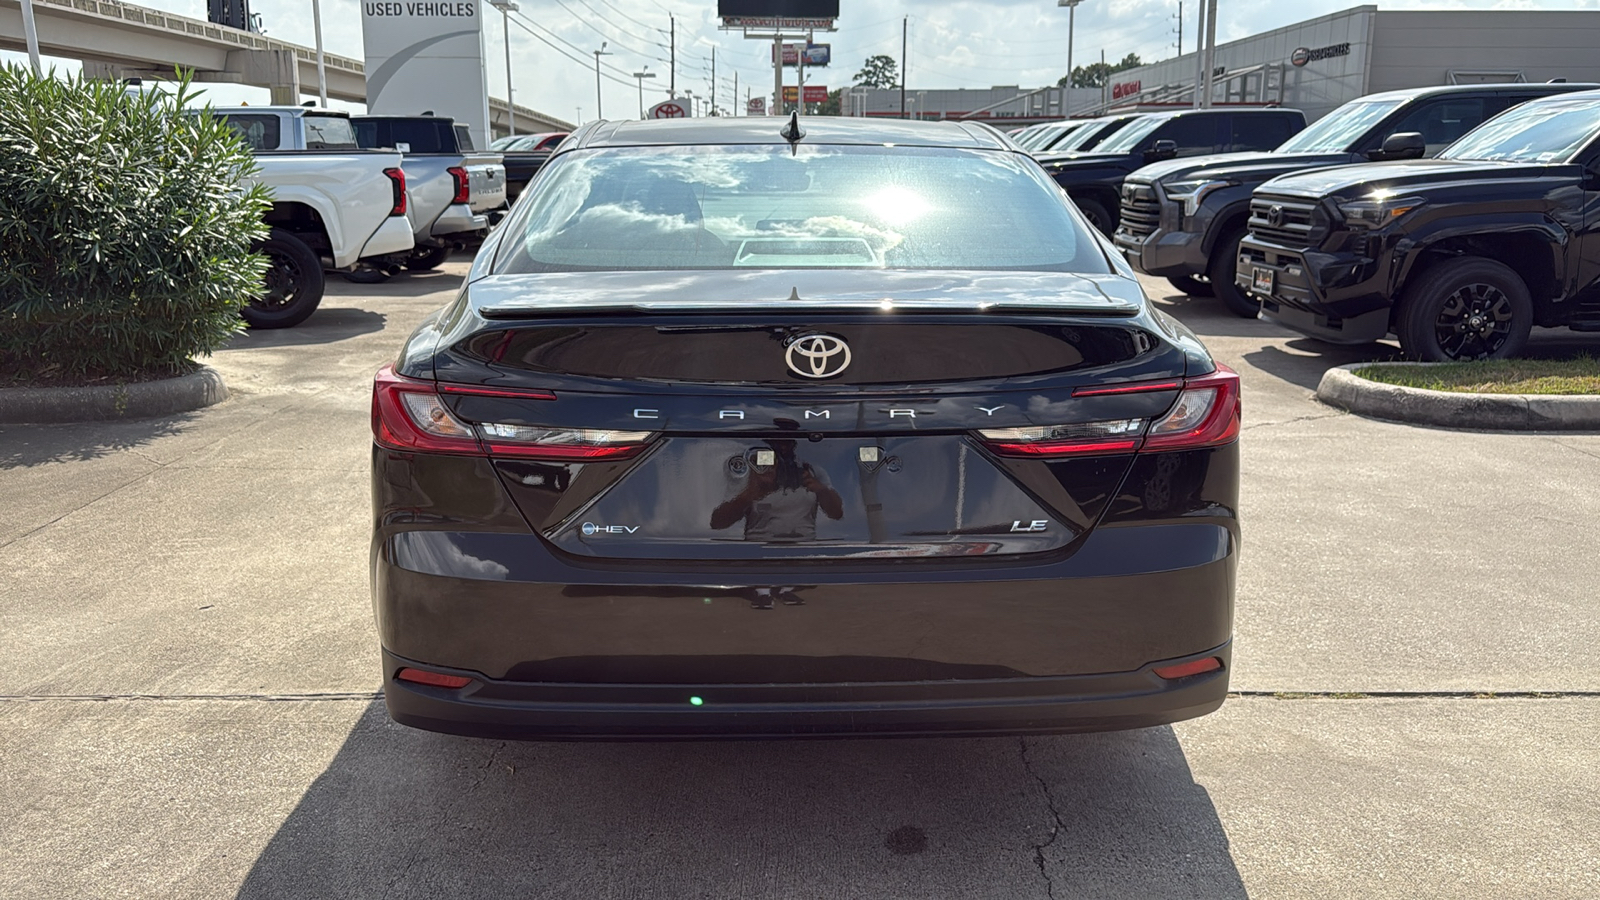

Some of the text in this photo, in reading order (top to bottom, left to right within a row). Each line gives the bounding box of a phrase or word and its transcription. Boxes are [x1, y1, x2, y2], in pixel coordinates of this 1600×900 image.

[366, 2, 474, 16] USED VEHICLES
[633, 405, 1006, 420] CAMRY
[594, 524, 641, 534] HEV
[1010, 519, 1049, 532] LE
